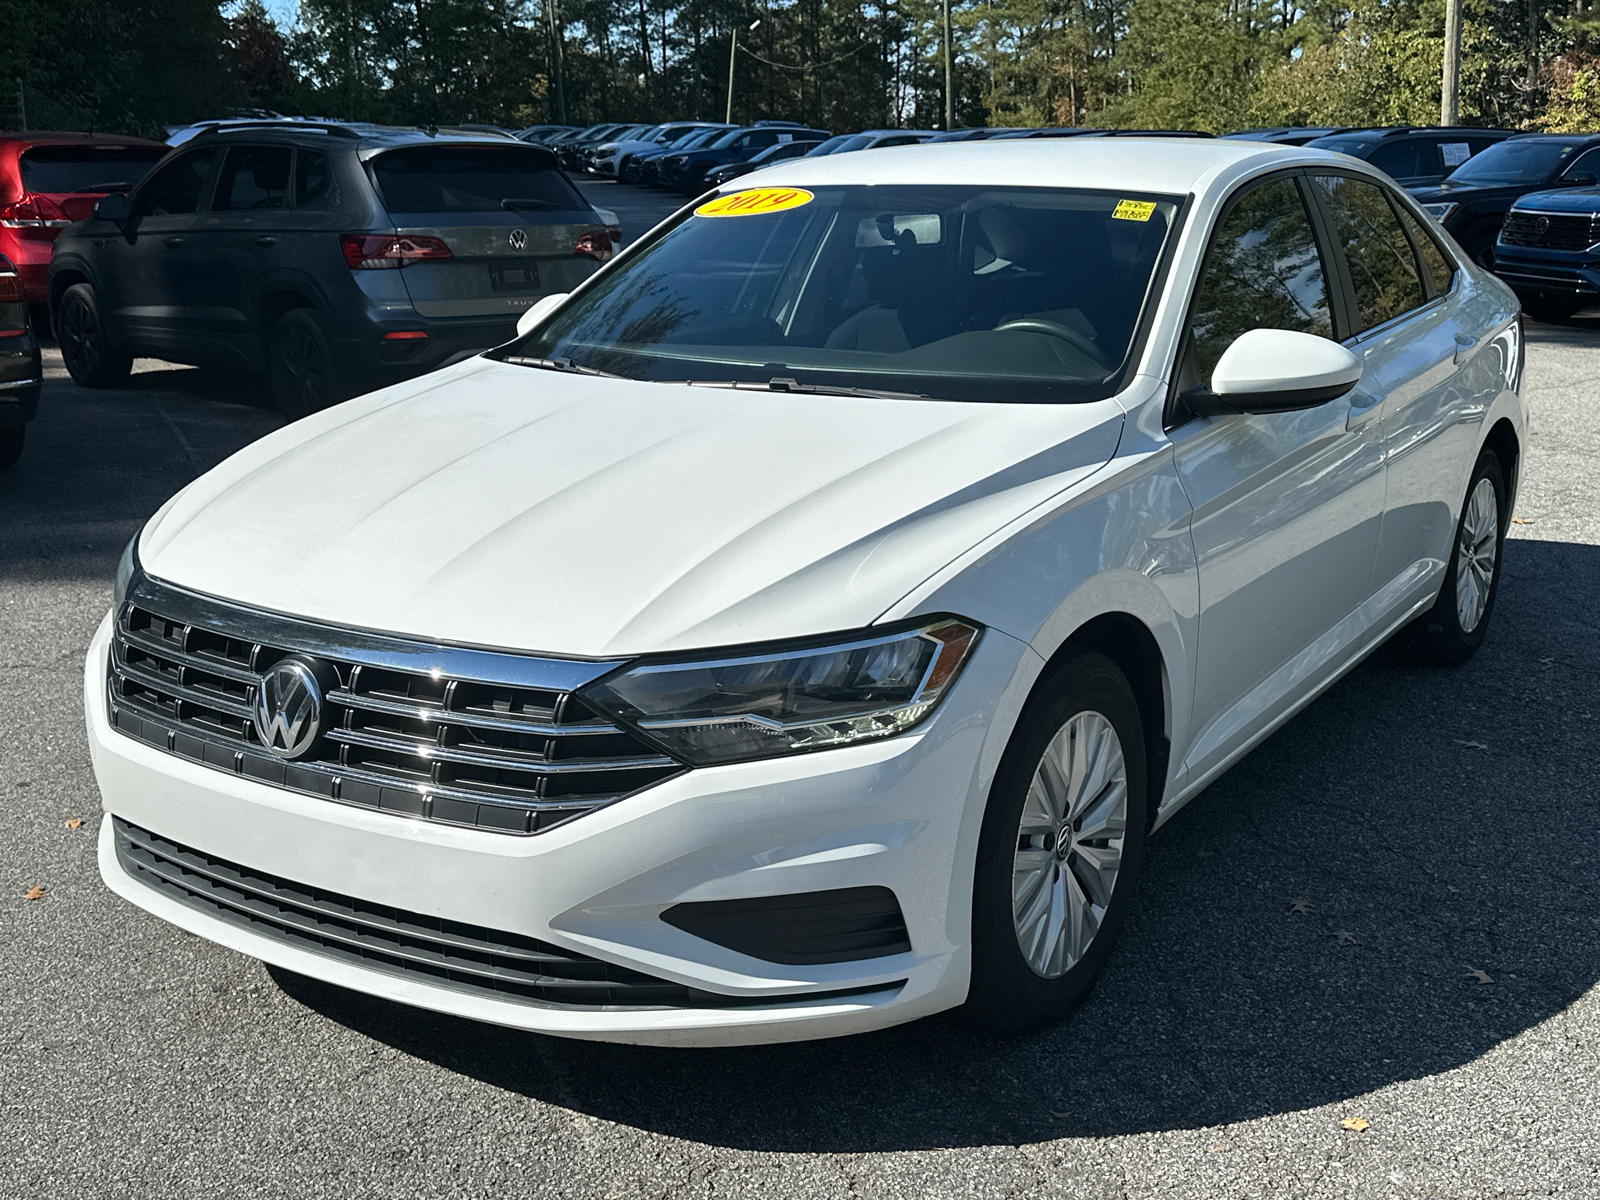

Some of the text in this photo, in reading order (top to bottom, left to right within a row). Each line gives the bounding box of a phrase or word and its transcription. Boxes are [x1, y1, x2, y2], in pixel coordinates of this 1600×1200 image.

[706, 192, 798, 213] 2019
[508, 229, 528, 251] VW
[255, 660, 320, 759] VW
